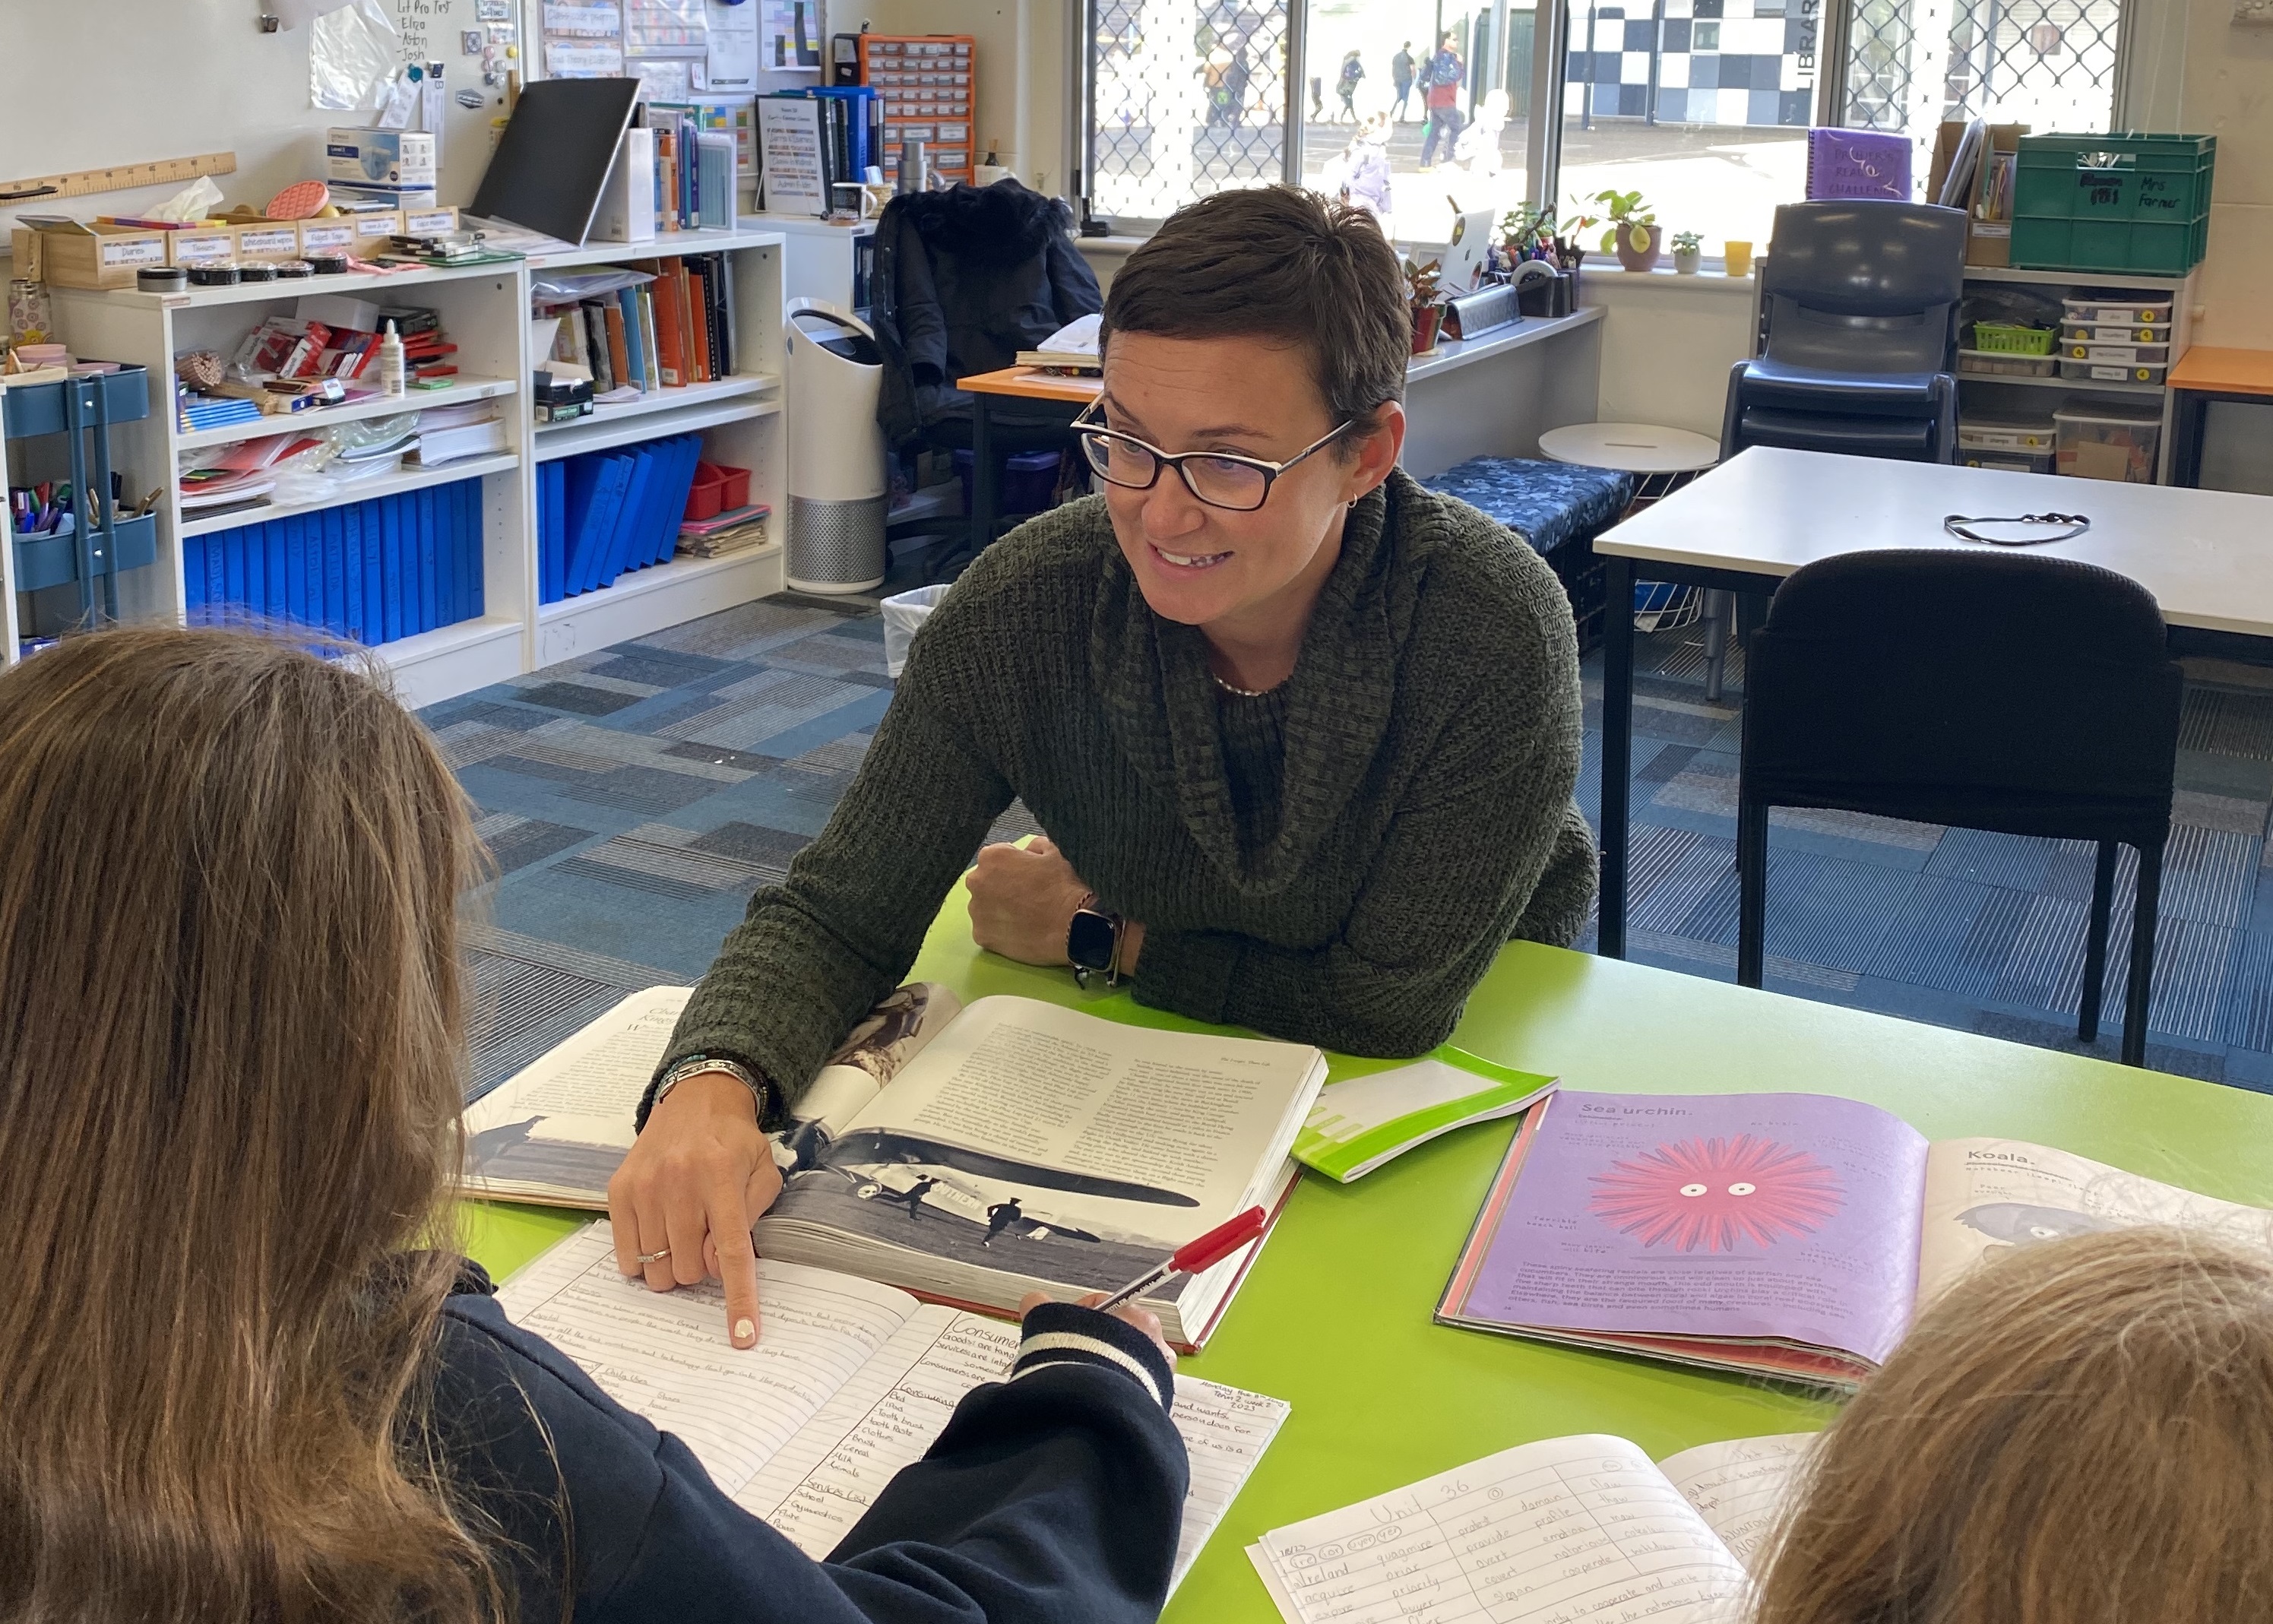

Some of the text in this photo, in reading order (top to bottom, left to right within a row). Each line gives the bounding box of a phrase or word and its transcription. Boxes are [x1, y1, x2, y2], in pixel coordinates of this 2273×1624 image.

[414, 1, 429, 14] Pro
[402, 48, 425, 62] Josh
[2140, 176, 2166, 192] Mrs
[1581, 1103, 1693, 1116] Sea urchin.
[1968, 1151, 2036, 1165] Koala.
[932, 1182, 983, 1211] OUTHERN
[977, 1341, 992, 1351] are
[1173, 1401, 1194, 1410] and
[1230, 1401, 1255, 1412] 2023
[1244, 1398, 1263, 1408] week
[1234, 1425, 1251, 1435] for
[1369, 1480, 1469, 1524] Unit 36
[1376, 1540, 1433, 1567] quagmire
[1645, 1577, 1664, 1592] and
